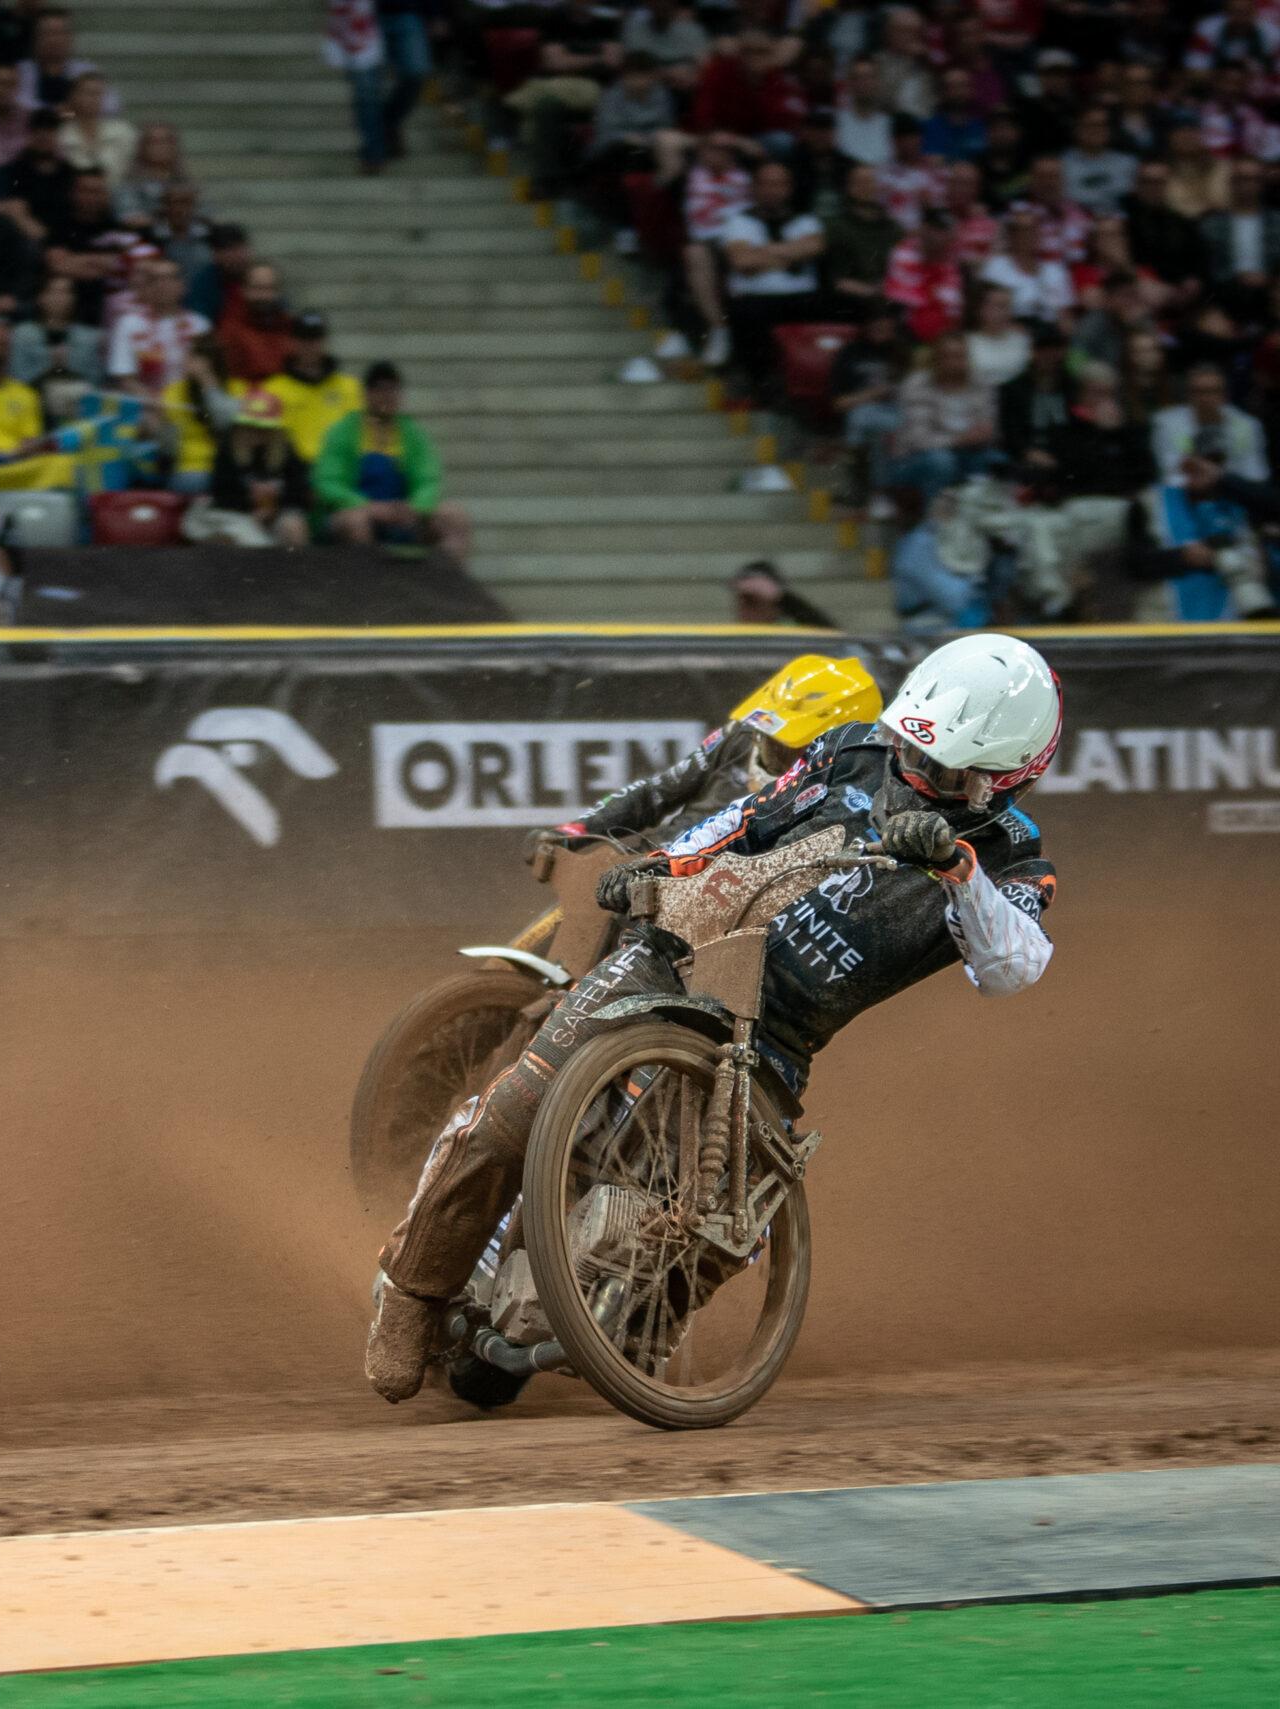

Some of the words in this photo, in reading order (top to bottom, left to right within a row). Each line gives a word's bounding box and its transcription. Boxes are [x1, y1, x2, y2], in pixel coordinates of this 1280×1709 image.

[1036, 727, 1280, 794] LATIN
[773, 913, 846, 984] ALITY
[794, 897, 864, 972] INITE
